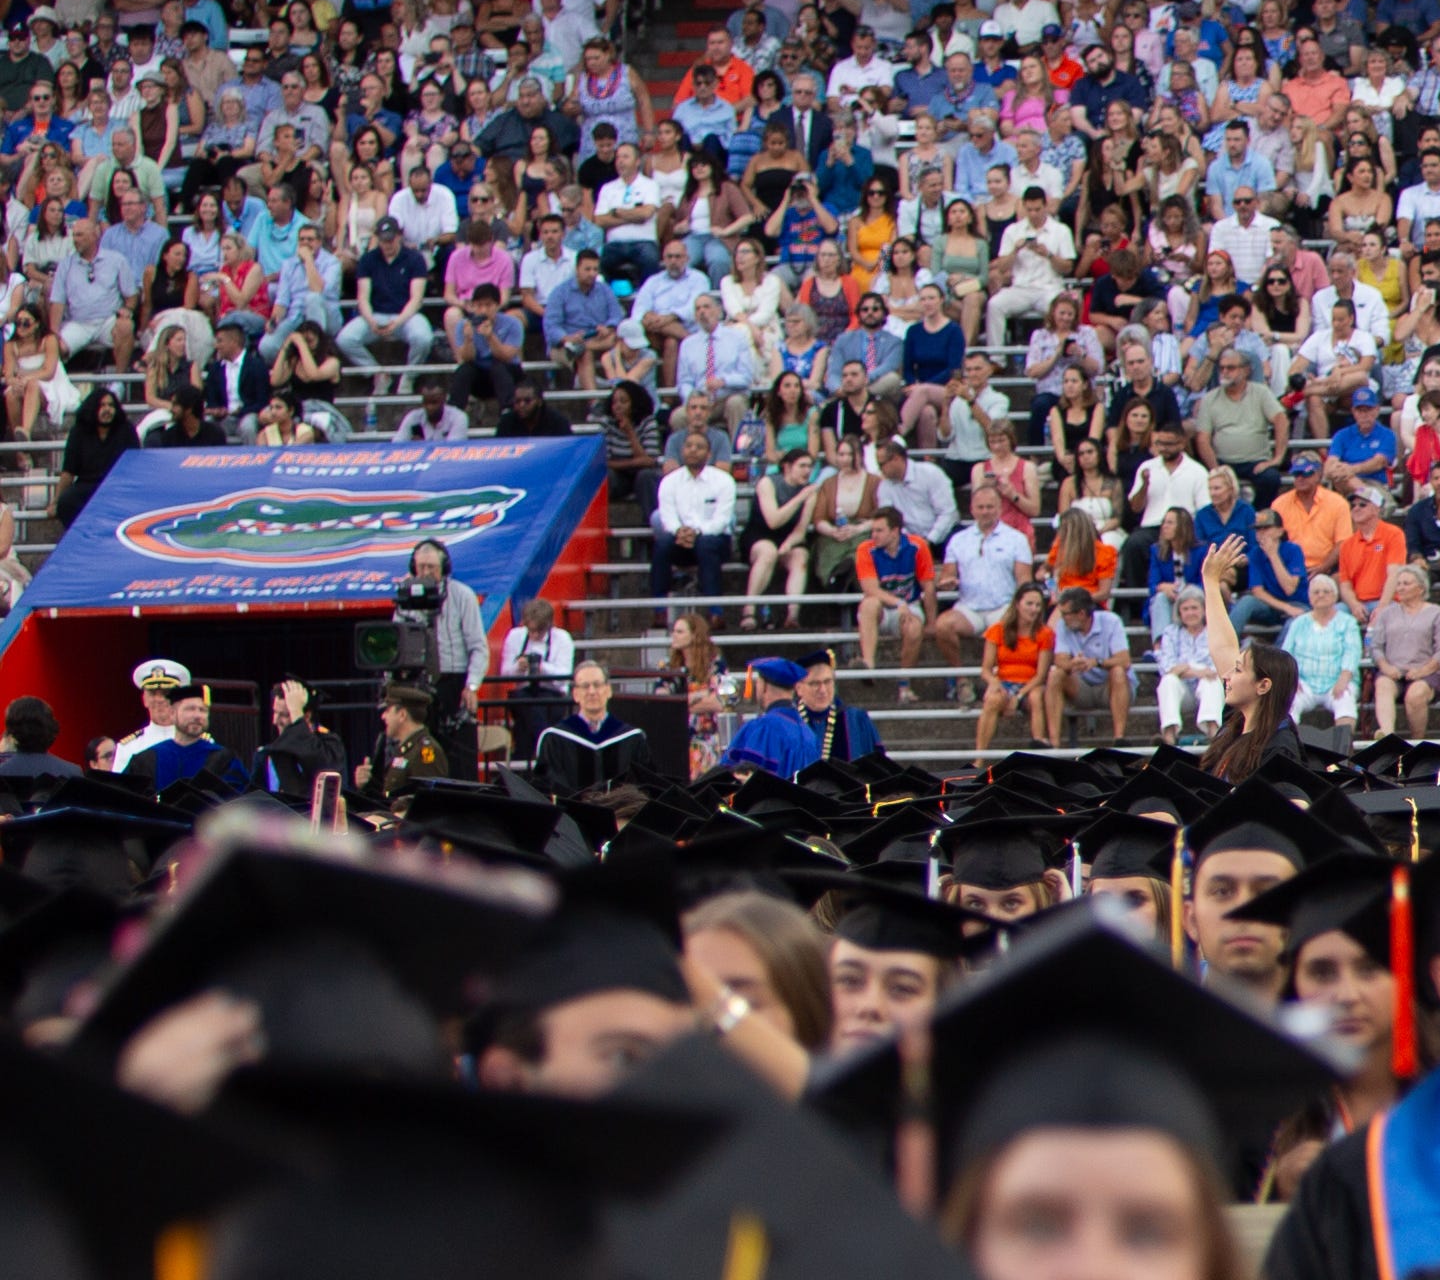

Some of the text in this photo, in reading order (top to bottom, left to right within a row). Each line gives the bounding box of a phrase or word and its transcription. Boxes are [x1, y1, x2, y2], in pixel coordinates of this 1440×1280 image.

[181, 453, 272, 468] BRYAN
[428, 444, 535, 461] FAMILY
[365, 462, 432, 476] ROOM
